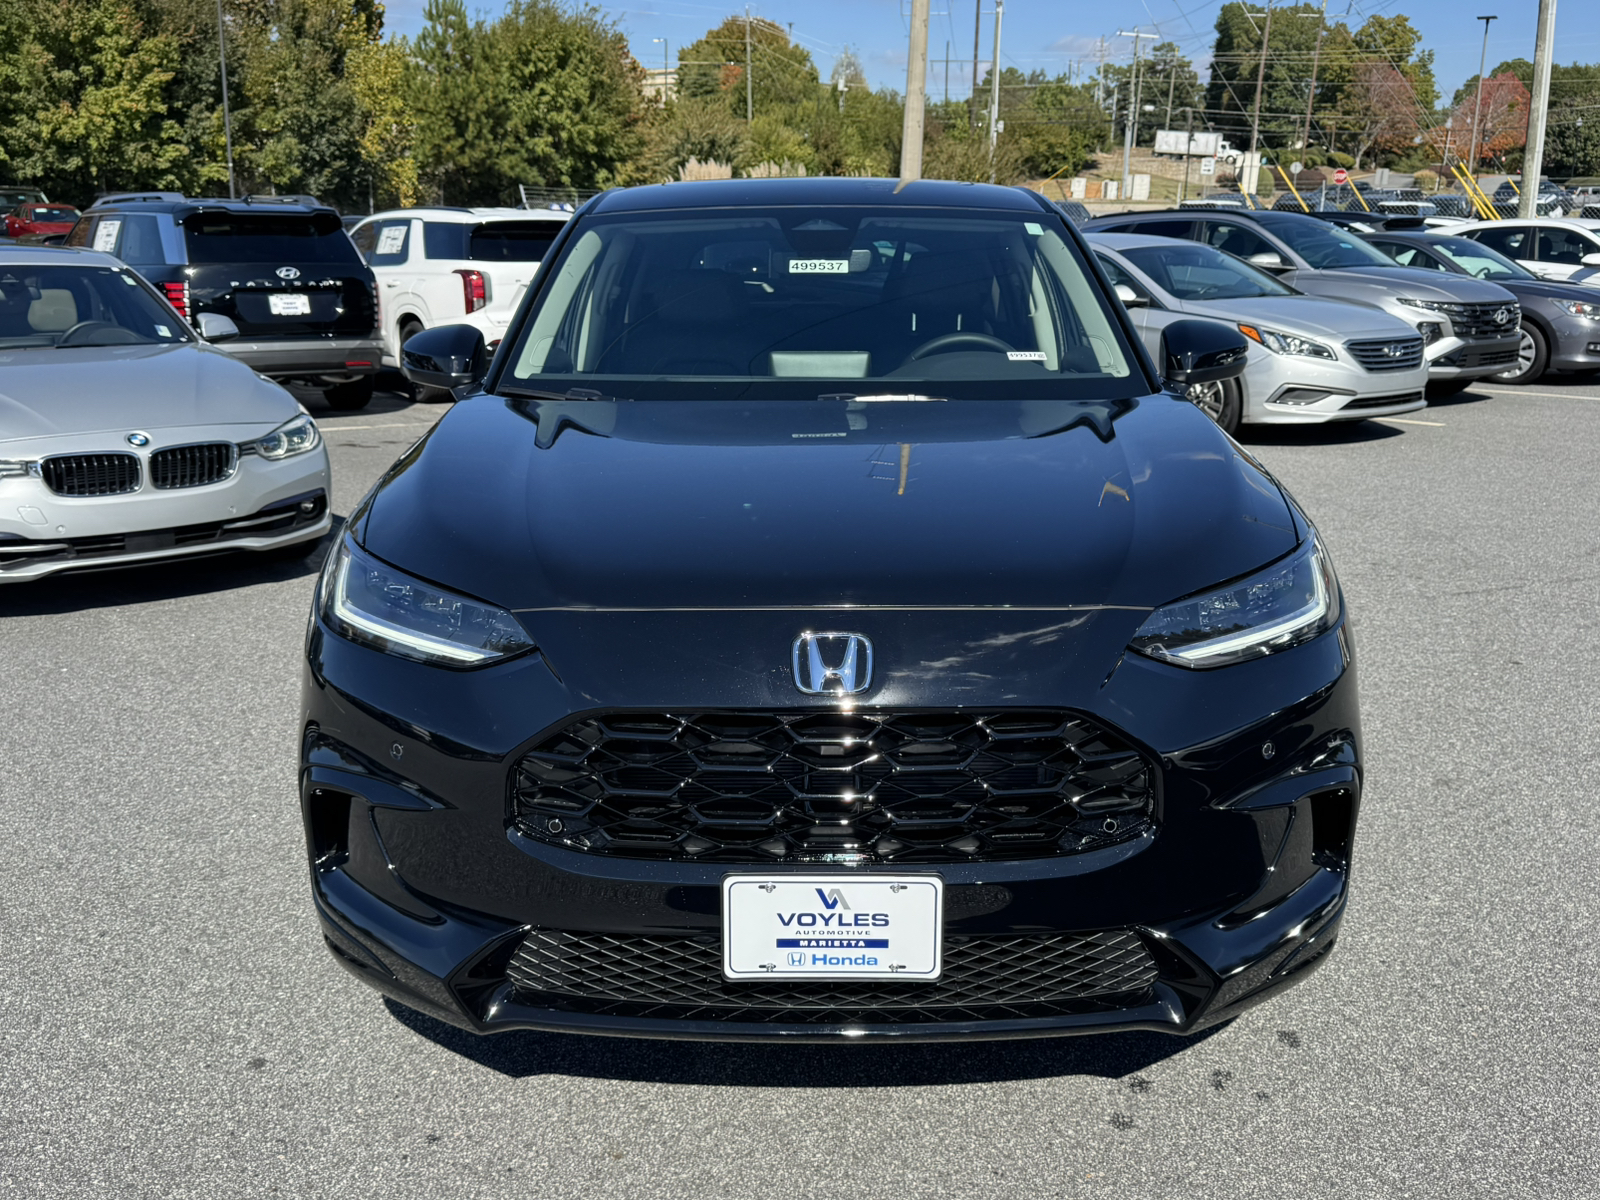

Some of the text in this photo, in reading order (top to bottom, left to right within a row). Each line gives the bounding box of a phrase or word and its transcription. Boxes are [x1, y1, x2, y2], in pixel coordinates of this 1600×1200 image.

[791, 262, 843, 270] 499537
[776, 913, 890, 927] VOYLES
[812, 954, 878, 965] Honda
